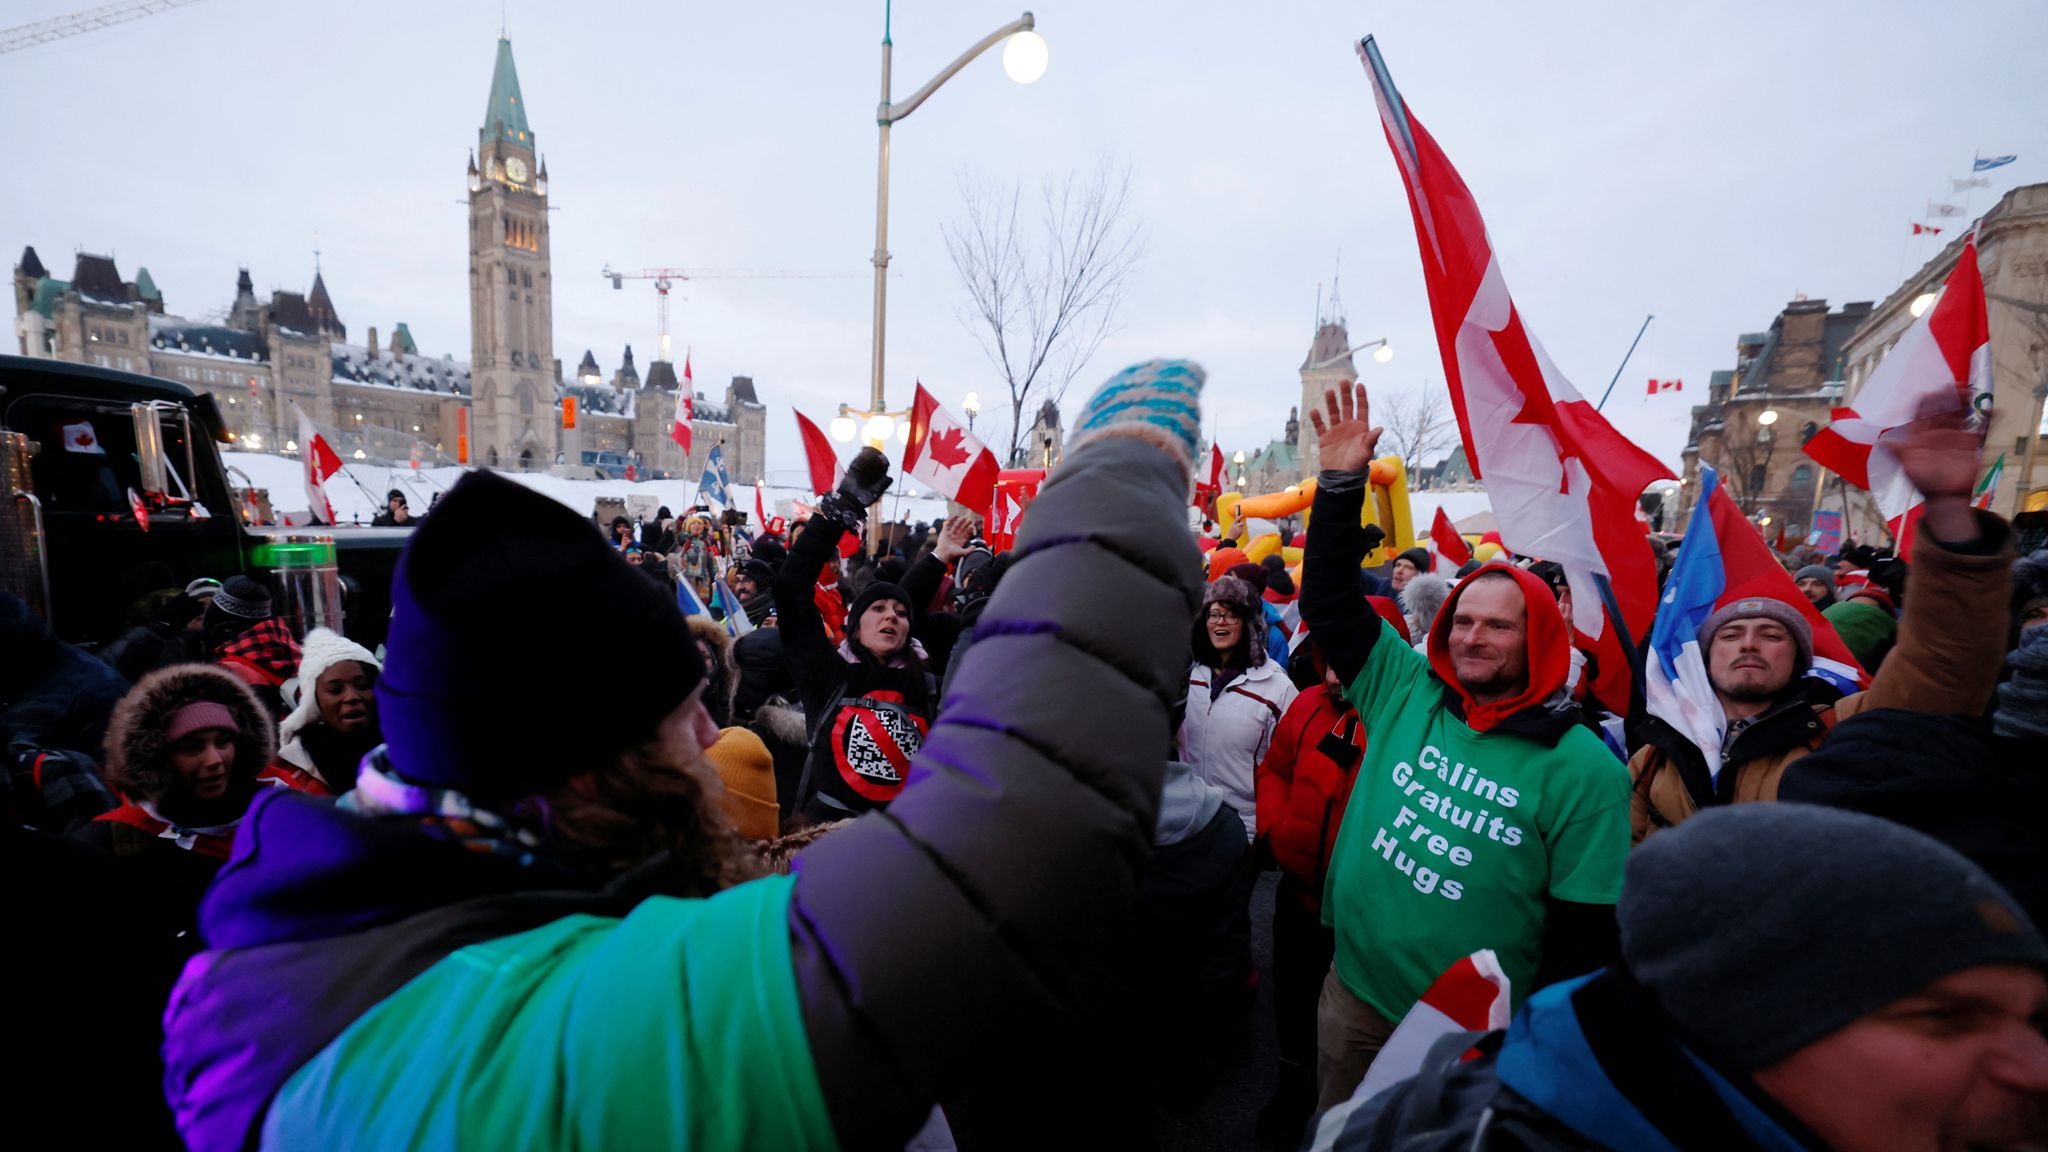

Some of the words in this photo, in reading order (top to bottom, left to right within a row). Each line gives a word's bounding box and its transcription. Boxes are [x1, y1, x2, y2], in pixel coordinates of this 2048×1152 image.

[1392, 761, 1523, 847] Gratuits
[1418, 745, 1520, 808] Câlins
[1371, 827, 1464, 901] Hugs
[1392, 805, 1473, 867] Free
